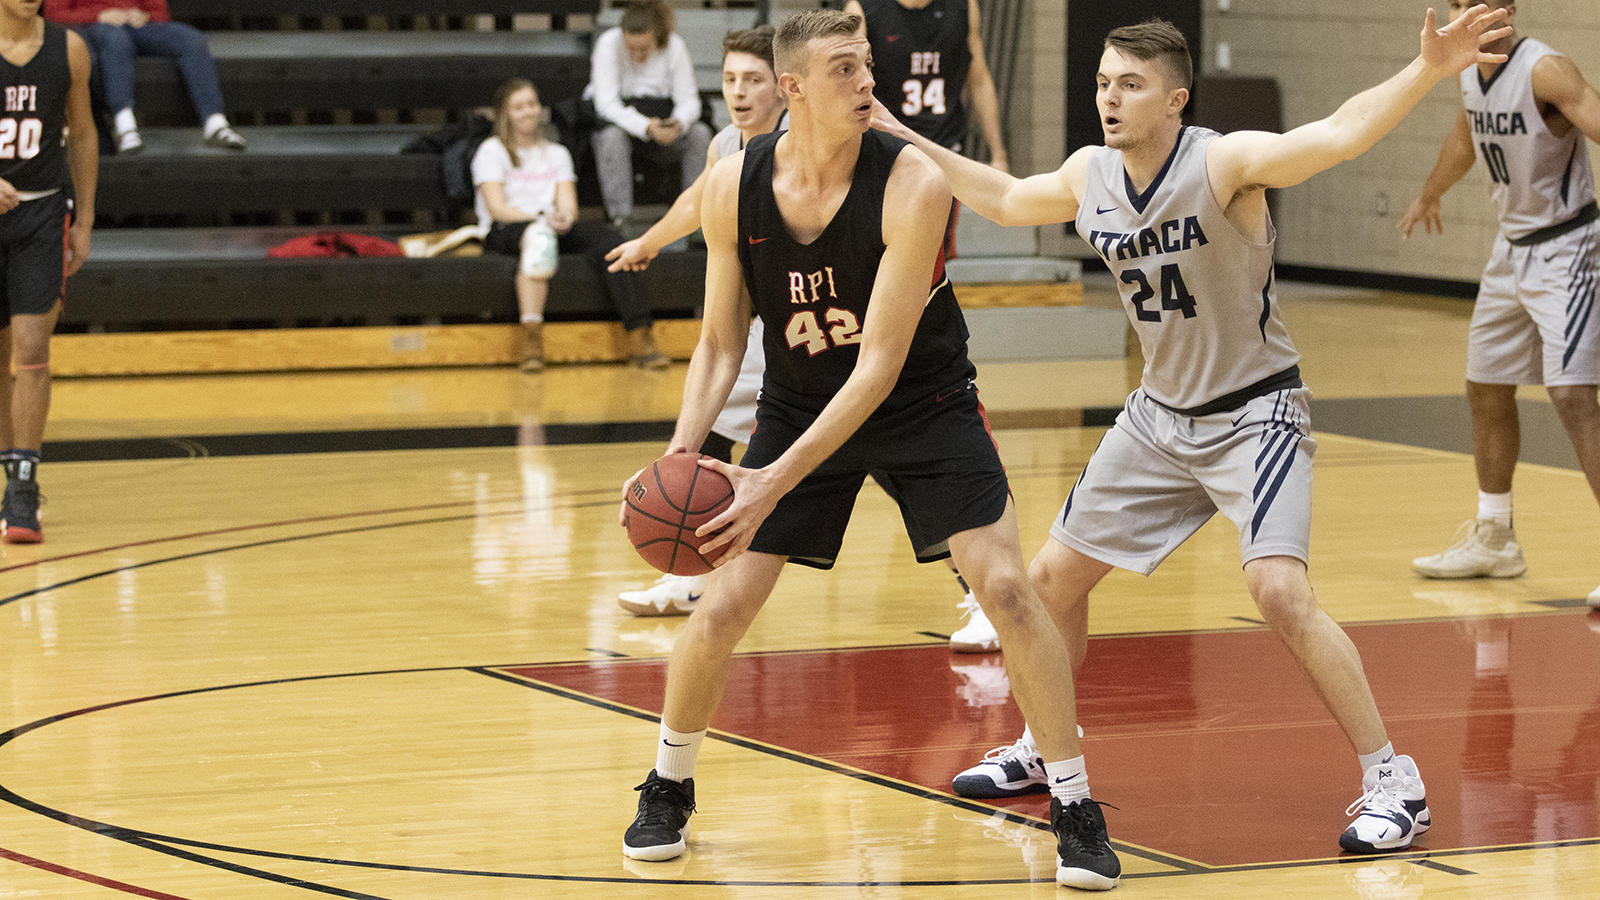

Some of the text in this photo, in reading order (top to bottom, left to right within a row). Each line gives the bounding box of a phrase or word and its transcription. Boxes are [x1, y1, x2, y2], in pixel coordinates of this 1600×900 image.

[910, 51, 941, 75] RPI
[4, 84, 37, 112] RPI
[901, 78, 947, 116] 34
[0, 117, 43, 160] 20
[1480, 142, 1511, 185] 10
[1089, 215, 1210, 262] ITHACA
[788, 266, 838, 304] RPI
[1119, 263, 1198, 322] 24
[784, 306, 862, 358] 42
